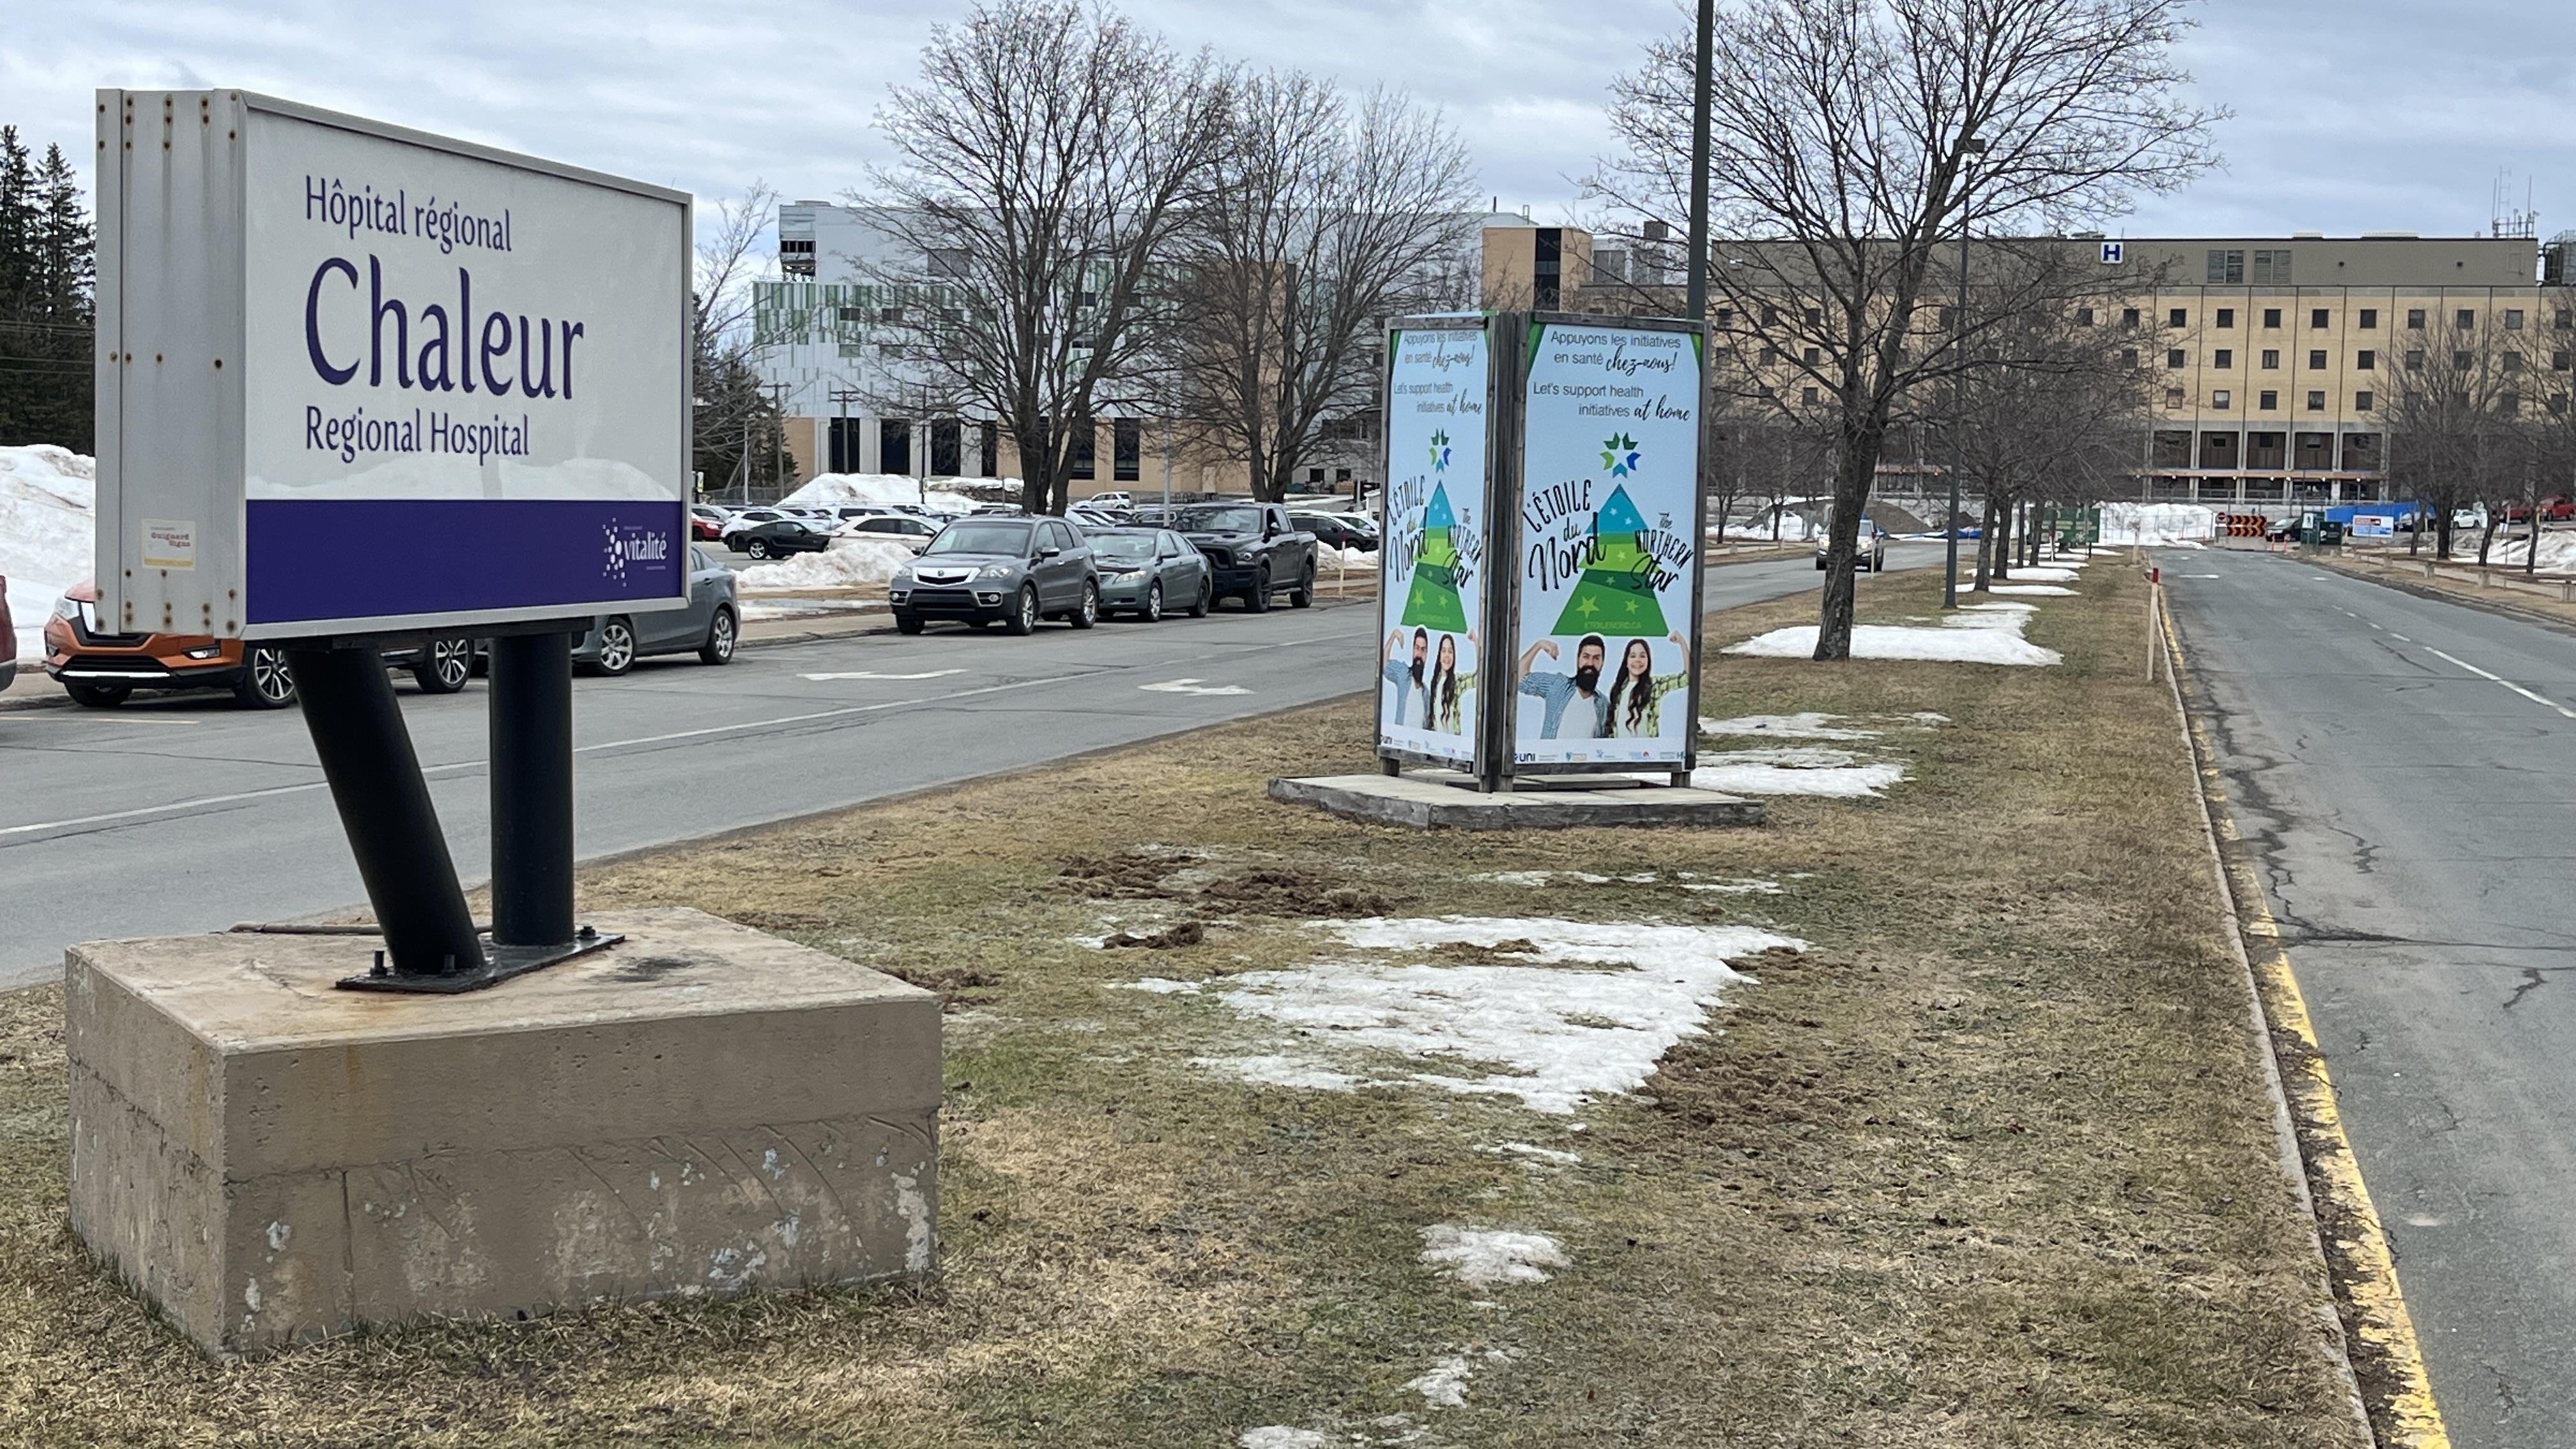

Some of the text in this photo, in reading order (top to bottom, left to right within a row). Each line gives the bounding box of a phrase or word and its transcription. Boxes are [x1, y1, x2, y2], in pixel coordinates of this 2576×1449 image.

[306, 175, 512, 254] Hôpital régional
[2103, 244, 2120, 261] H
[305, 254, 584, 399] Chaleur
[1404, 330, 1478, 346] Appuyons les initiatives
[1551, 330, 1681, 348] Appuyons les initiatives
[1405, 342, 1476, 372] en santé chez-nous!
[1554, 345, 1678, 376] en santé chez-nous!
[1393, 381, 1453, 397] Let's support health
[1416, 388, 1483, 417] initiatives at home
[1533, 381, 1644, 399] Let's support health
[1579, 394, 1692, 422] initiatives at home
[307, 405, 530, 466] Regional Hospital
[1407, 512, 1418, 535] du
[1563, 517, 1581, 542] du
[1659, 512, 1673, 529] The
[623, 531, 668, 561] vitalité
[1390, 506, 1430, 583] Nord
[1528, 512, 1607, 591] Nord
[1634, 529, 1694, 570] NORTHERN
[1441, 549, 1475, 588] Star
[1630, 554, 1679, 592] Star
